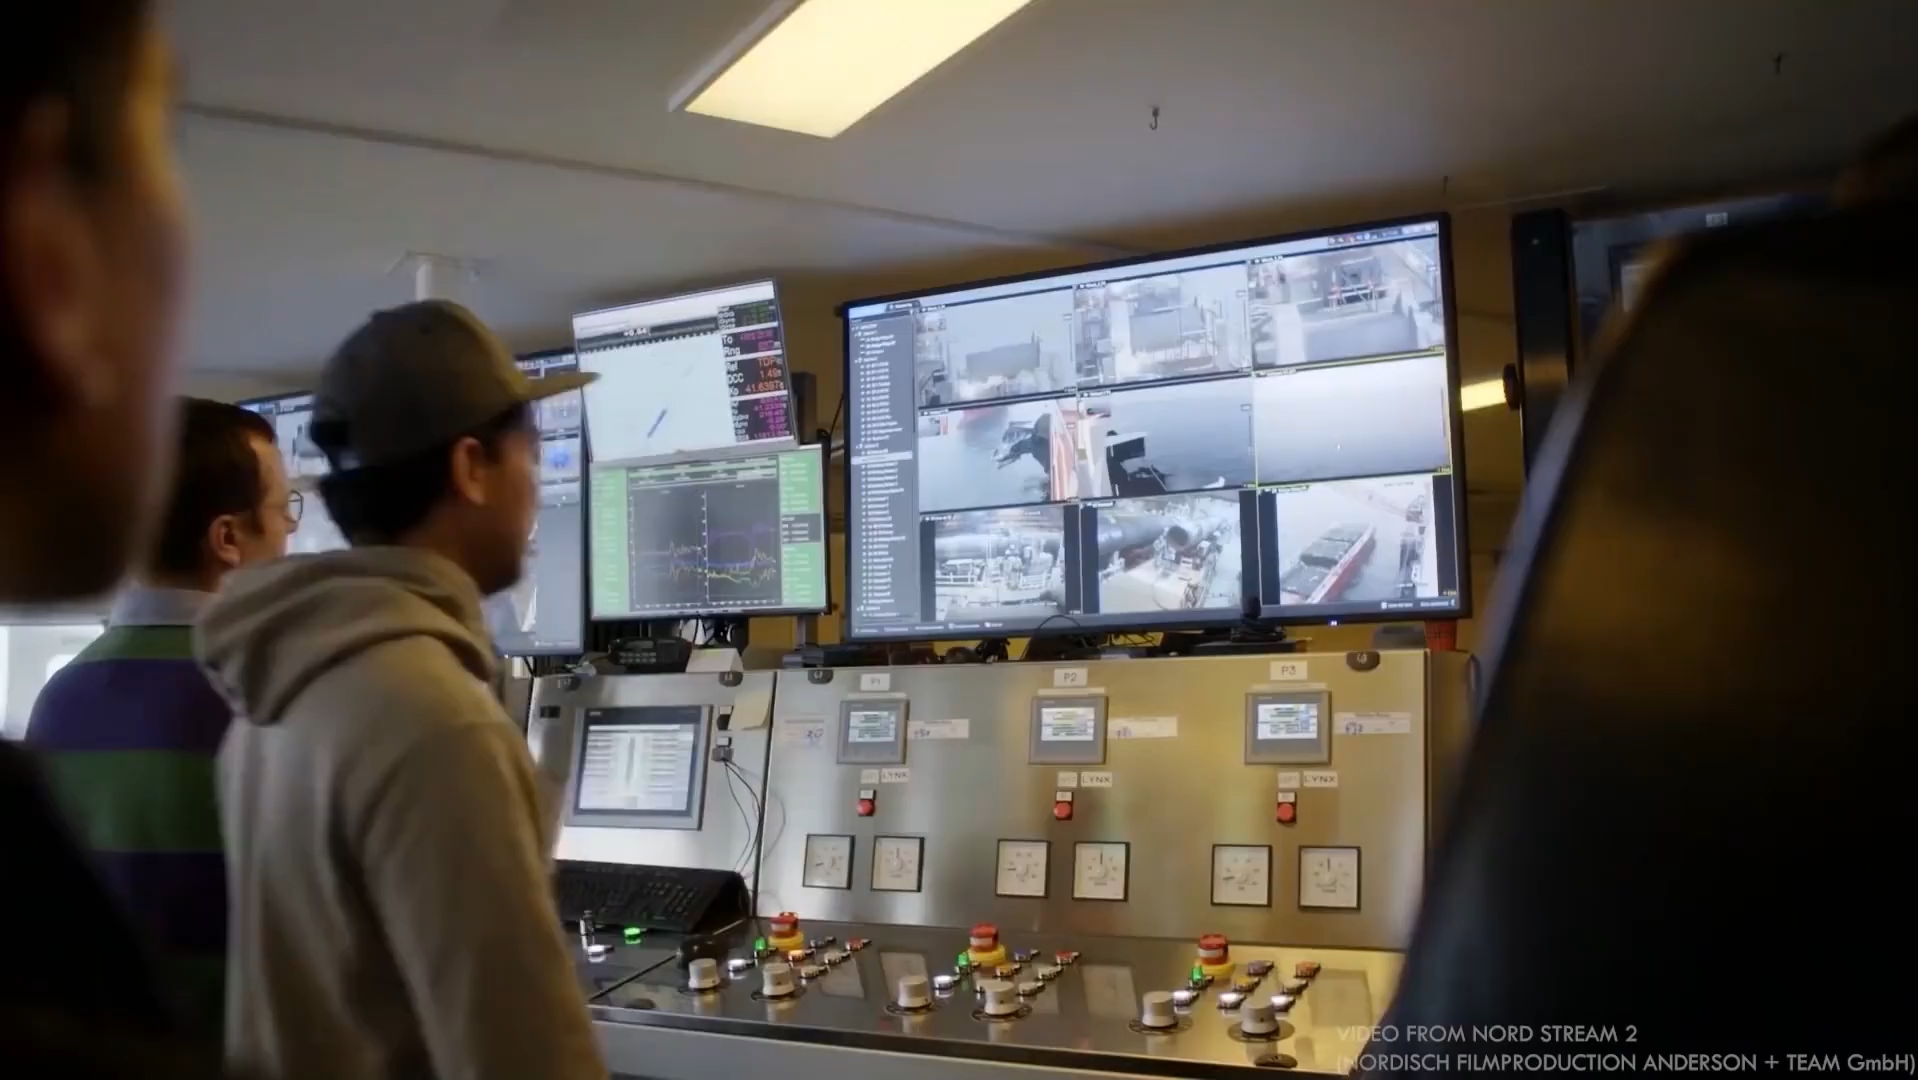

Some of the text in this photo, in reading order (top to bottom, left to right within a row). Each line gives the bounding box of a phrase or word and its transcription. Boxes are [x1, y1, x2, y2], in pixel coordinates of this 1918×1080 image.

[1281, 665, 1296, 676] P3
[1064, 672, 1077, 683] P2
[1082, 775, 1112, 784] LYNX
[1304, 775, 1336, 784] LYNX
